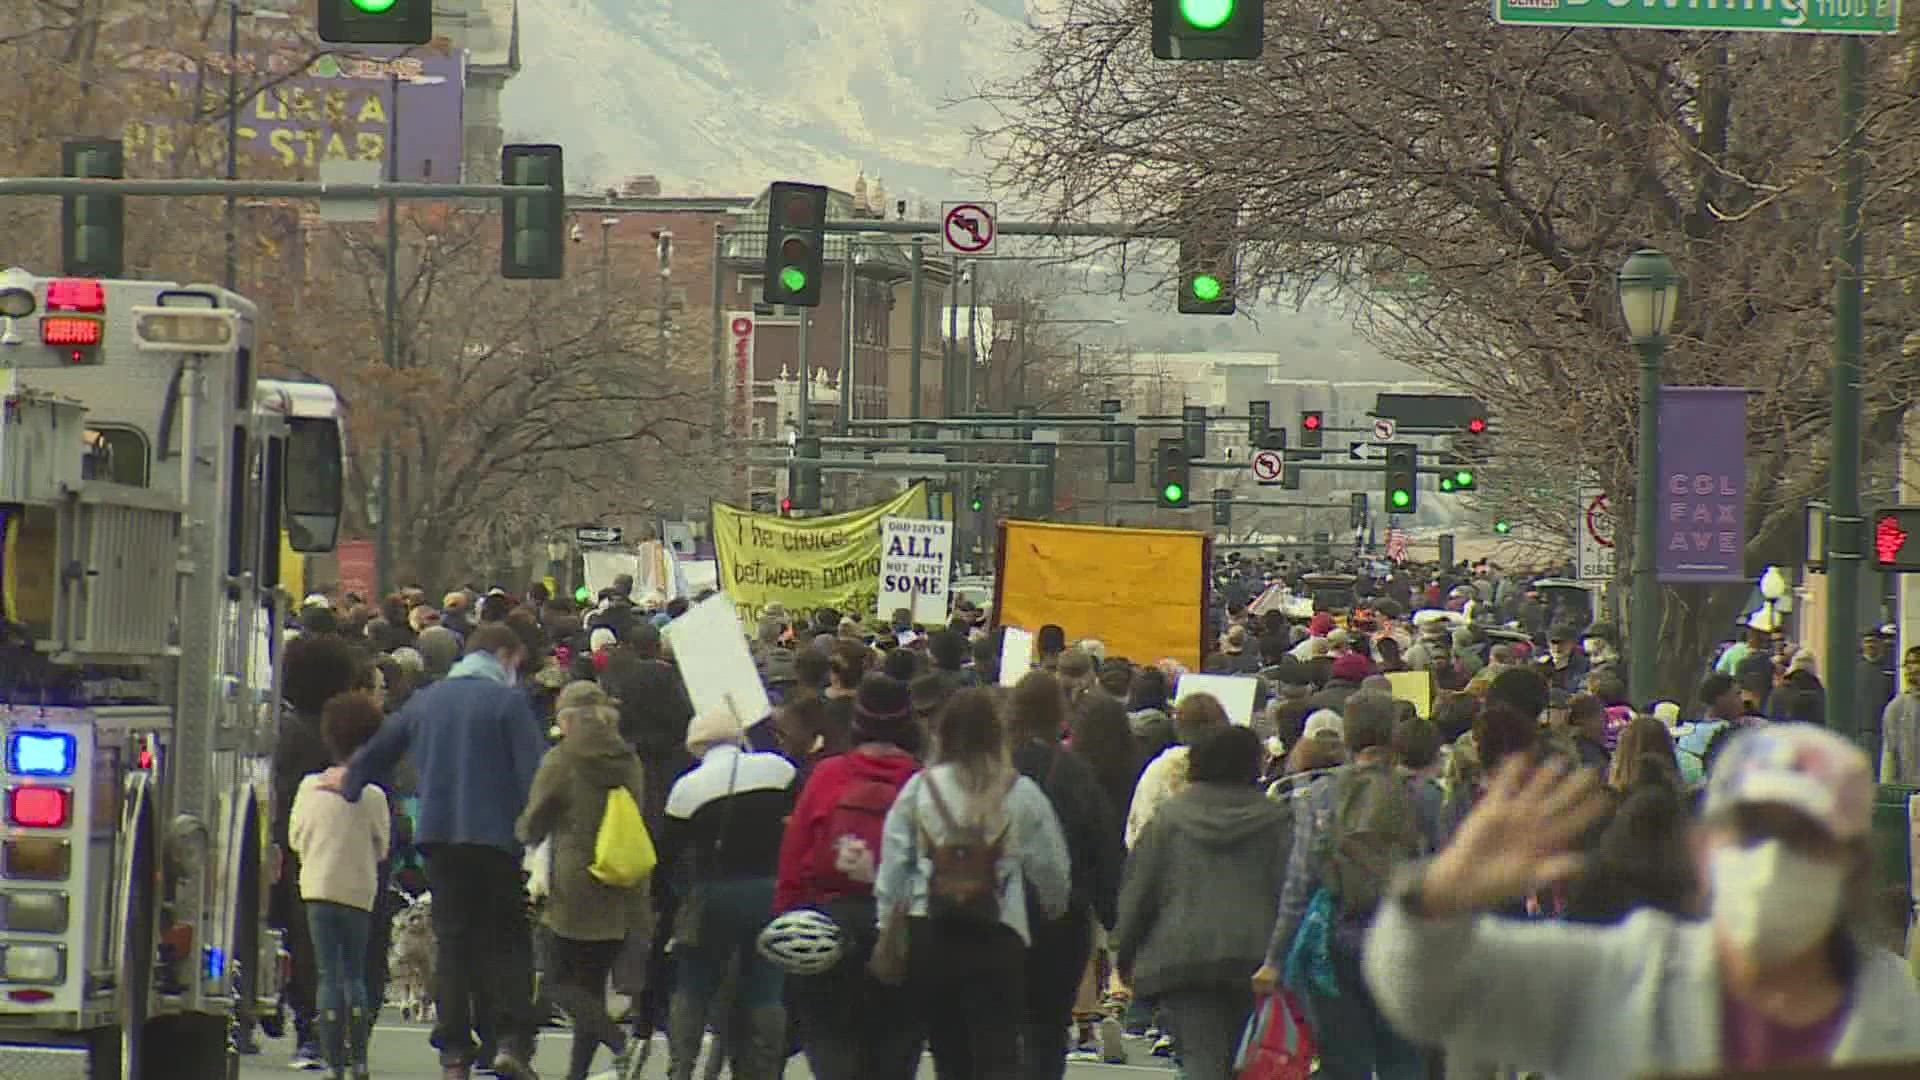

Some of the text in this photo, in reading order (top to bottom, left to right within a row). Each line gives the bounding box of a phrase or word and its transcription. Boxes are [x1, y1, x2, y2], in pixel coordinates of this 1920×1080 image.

[1668, 473, 1738, 496] COL
[1668, 502, 1738, 524] FAX
[731, 512, 775, 550] The
[912, 524, 946, 535] LOVES
[887, 535, 944, 563] ALL,
[1668, 531, 1738, 553] AVE
[733, 552, 881, 592] between nonvio
[886, 562, 944, 577] NOT JUST
[884, 575, 942, 595] SOME
